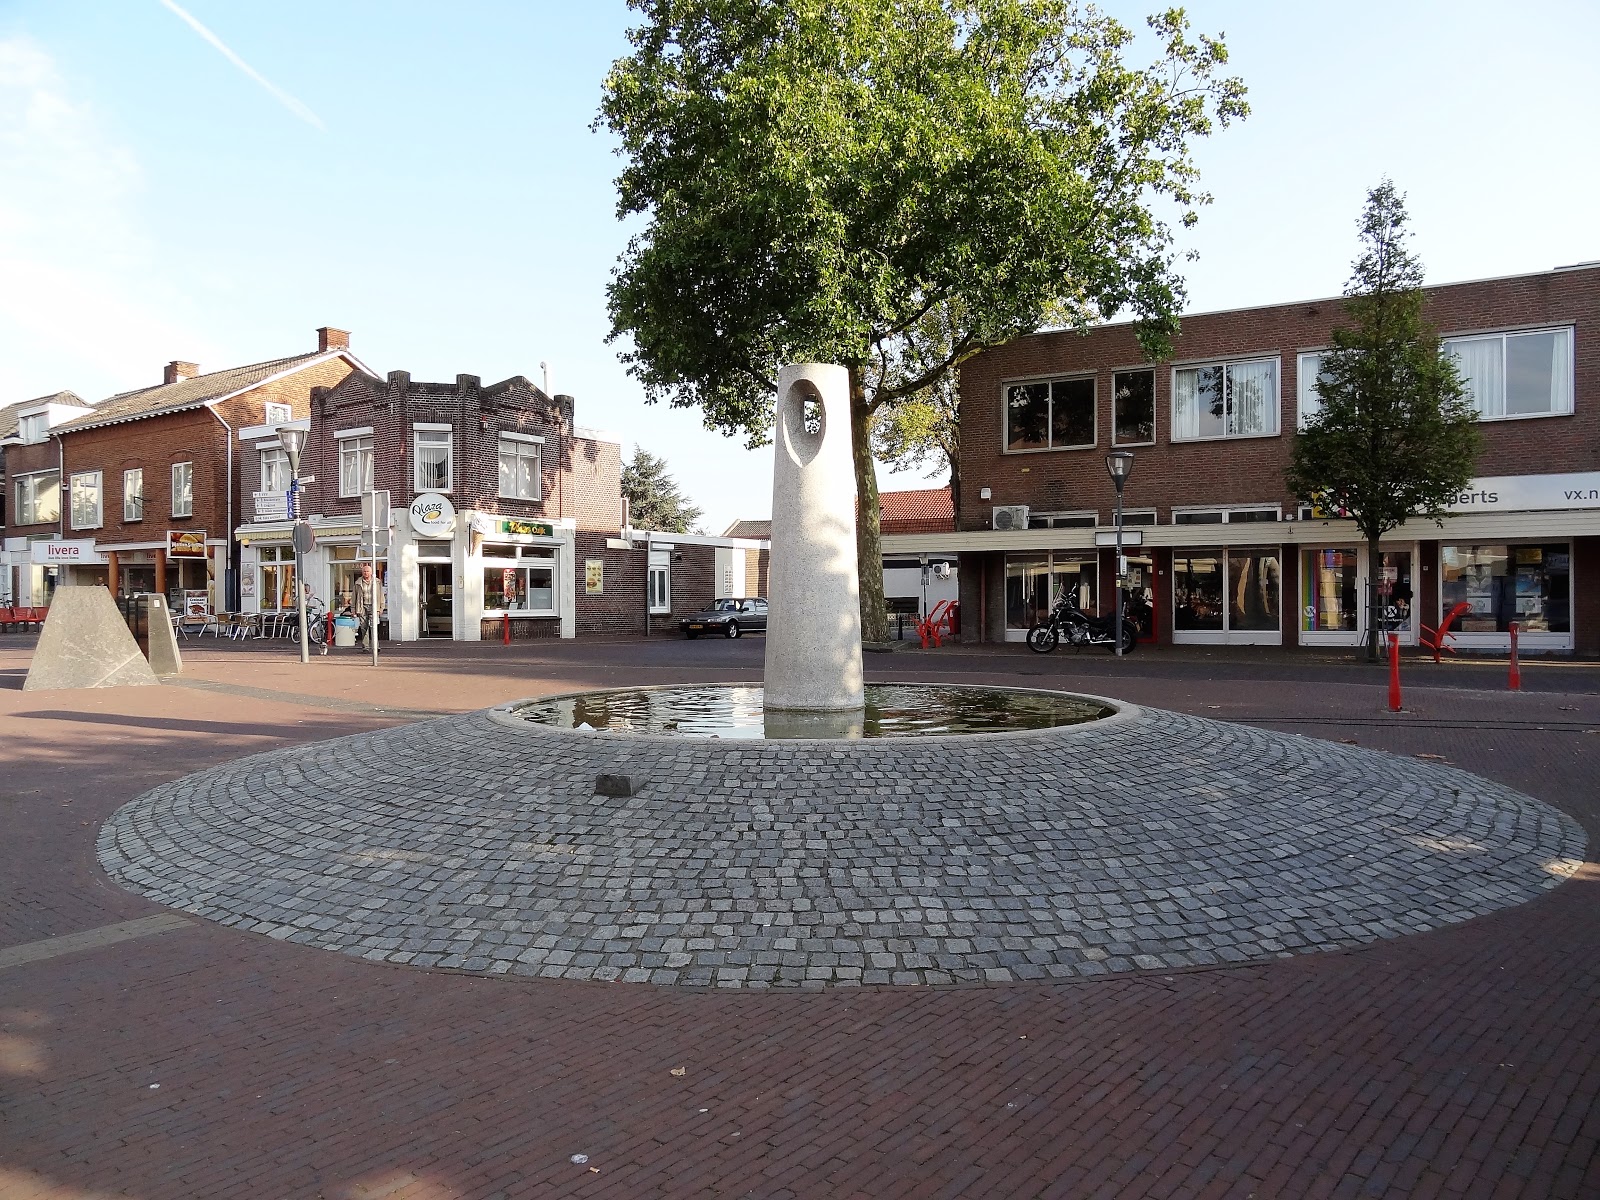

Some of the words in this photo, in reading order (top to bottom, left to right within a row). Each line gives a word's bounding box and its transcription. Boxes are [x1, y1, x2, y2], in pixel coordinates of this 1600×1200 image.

[1445, 490, 1499, 508] perts
[412, 503, 443, 517] Plaza
[48, 544, 79, 555] livera
